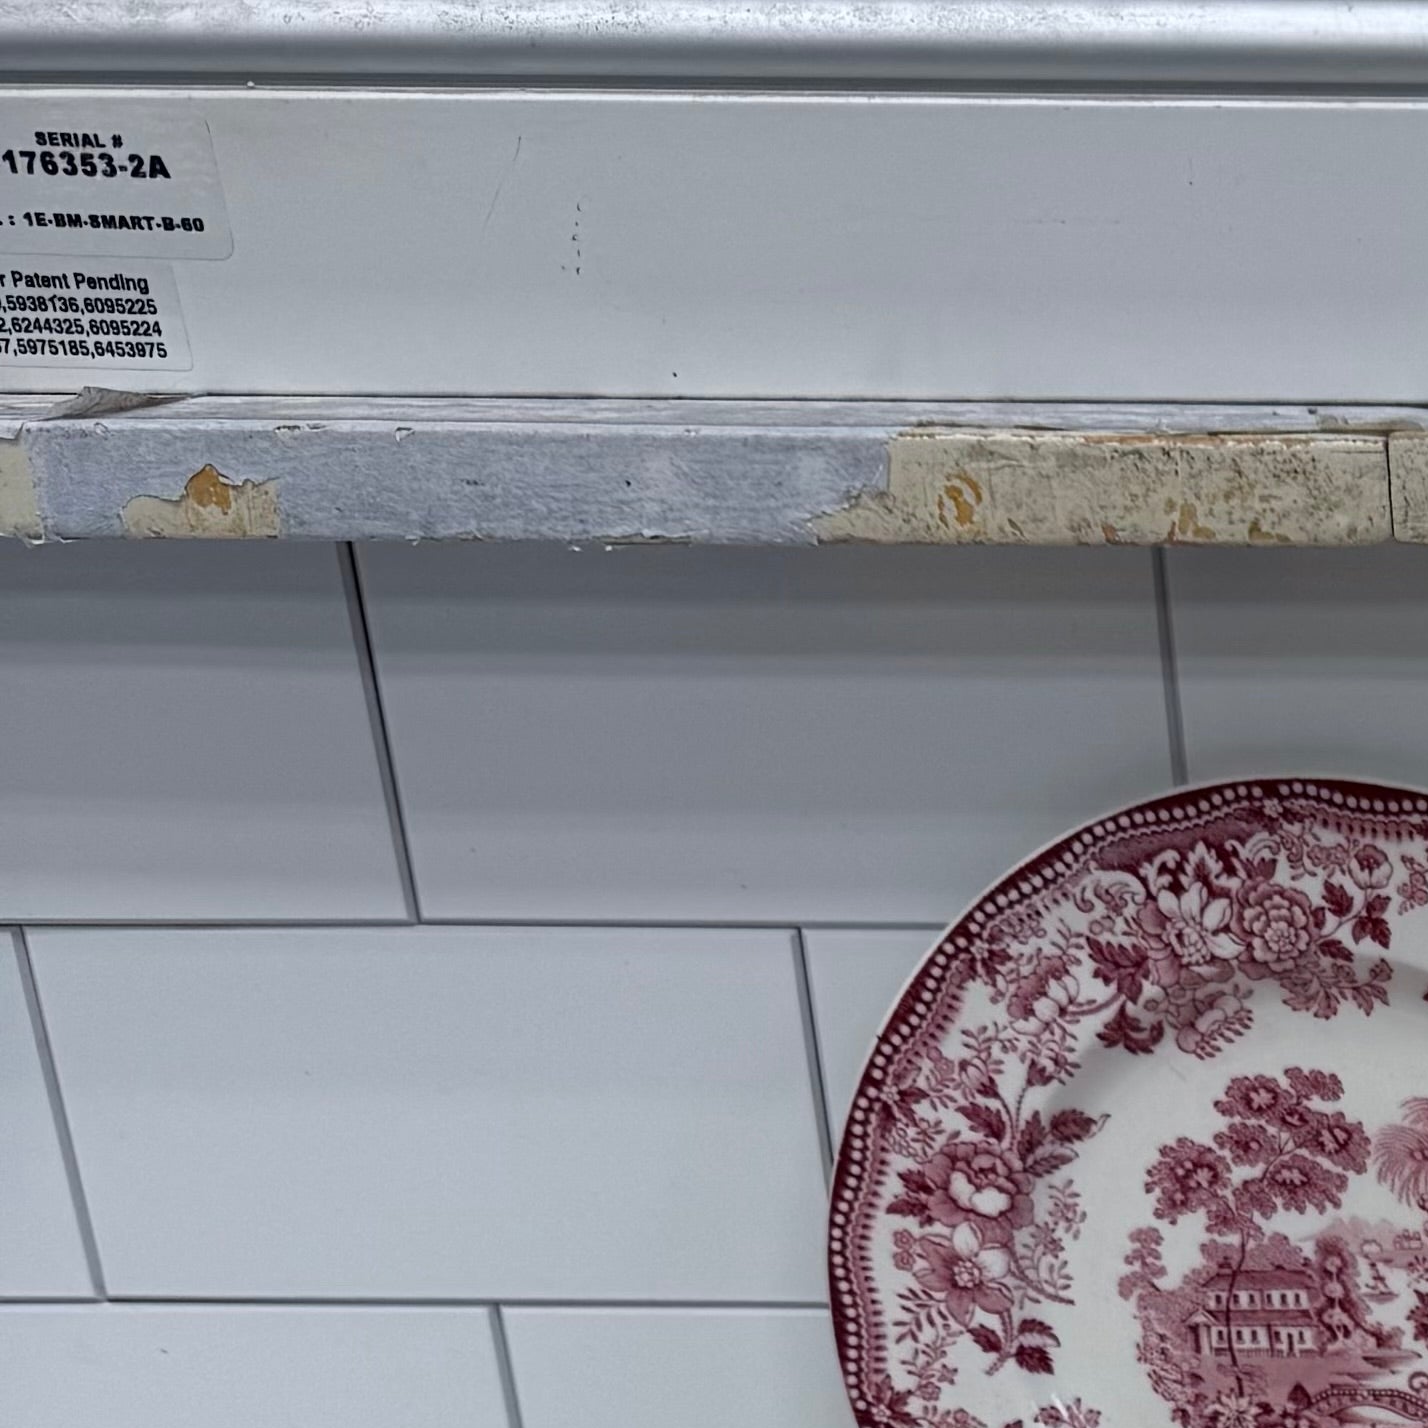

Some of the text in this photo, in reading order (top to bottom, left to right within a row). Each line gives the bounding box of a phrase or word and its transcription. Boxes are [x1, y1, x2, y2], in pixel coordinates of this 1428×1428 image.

[35, 131, 123, 148] SERIAL #
[2, 149, 171, 179] 176353-2A
[11, 270, 71, 289] Patent
[73, 272, 149, 295] Pending
[0, 294, 158, 315] ,5938136,6095225
[0, 338, 167, 359] 7,5975185,6453975
